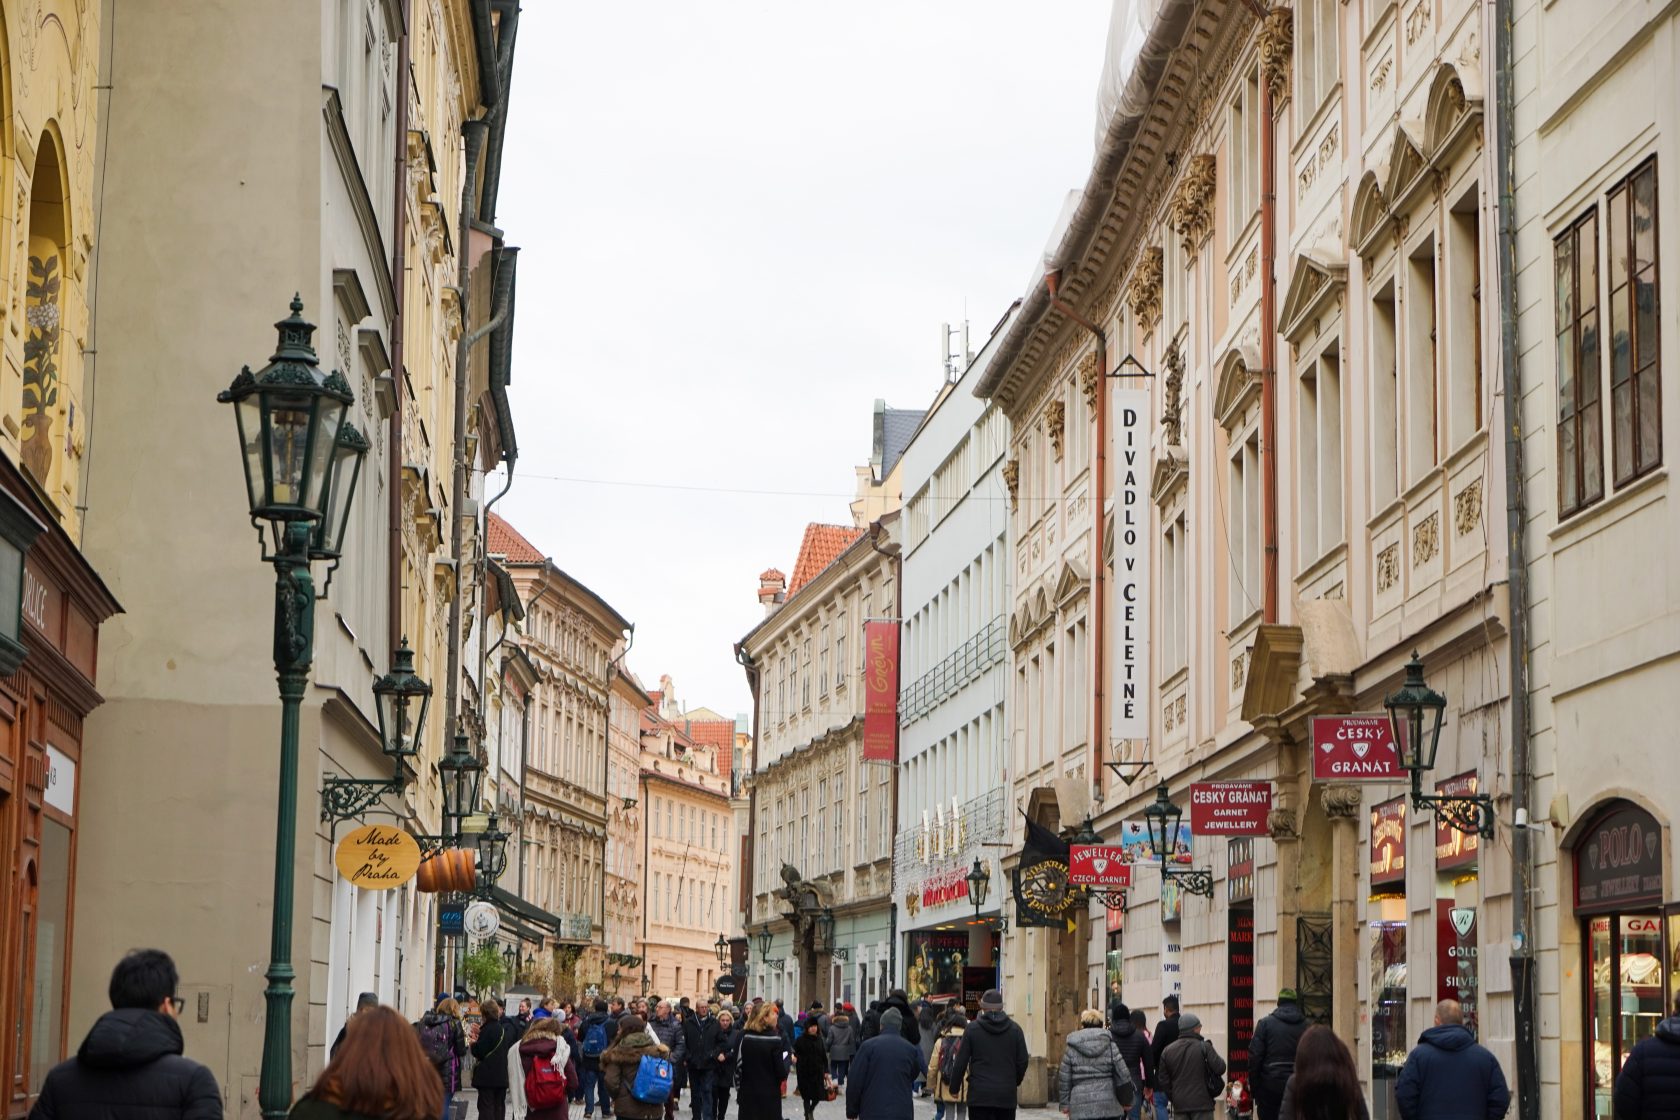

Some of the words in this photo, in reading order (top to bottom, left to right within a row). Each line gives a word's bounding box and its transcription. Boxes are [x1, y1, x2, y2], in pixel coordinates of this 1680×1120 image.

[1123, 409, 1137, 545] DIVADLO
[1123, 583, 1137, 719] CELETNÉ
[1336, 726, 1384, 740] ČESKÝ
[1331, 760, 1390, 773] GRANÁT
[1193, 789, 1226, 804] ČESKÝ
[1228, 789, 1268, 804] GRÁNAT
[1204, 821, 1258, 829] JEWELLERY
[356, 827, 401, 846] Made
[1599, 823, 1642, 870] POLO
[368, 848, 390, 868] by
[1073, 848, 1122, 864] JEWELLER
[351, 862, 400, 881] Praha
[1072, 874, 1096, 883] CZECH
[1099, 876, 1127, 884] GARNET
[1448, 946, 1478, 957] GOLD
